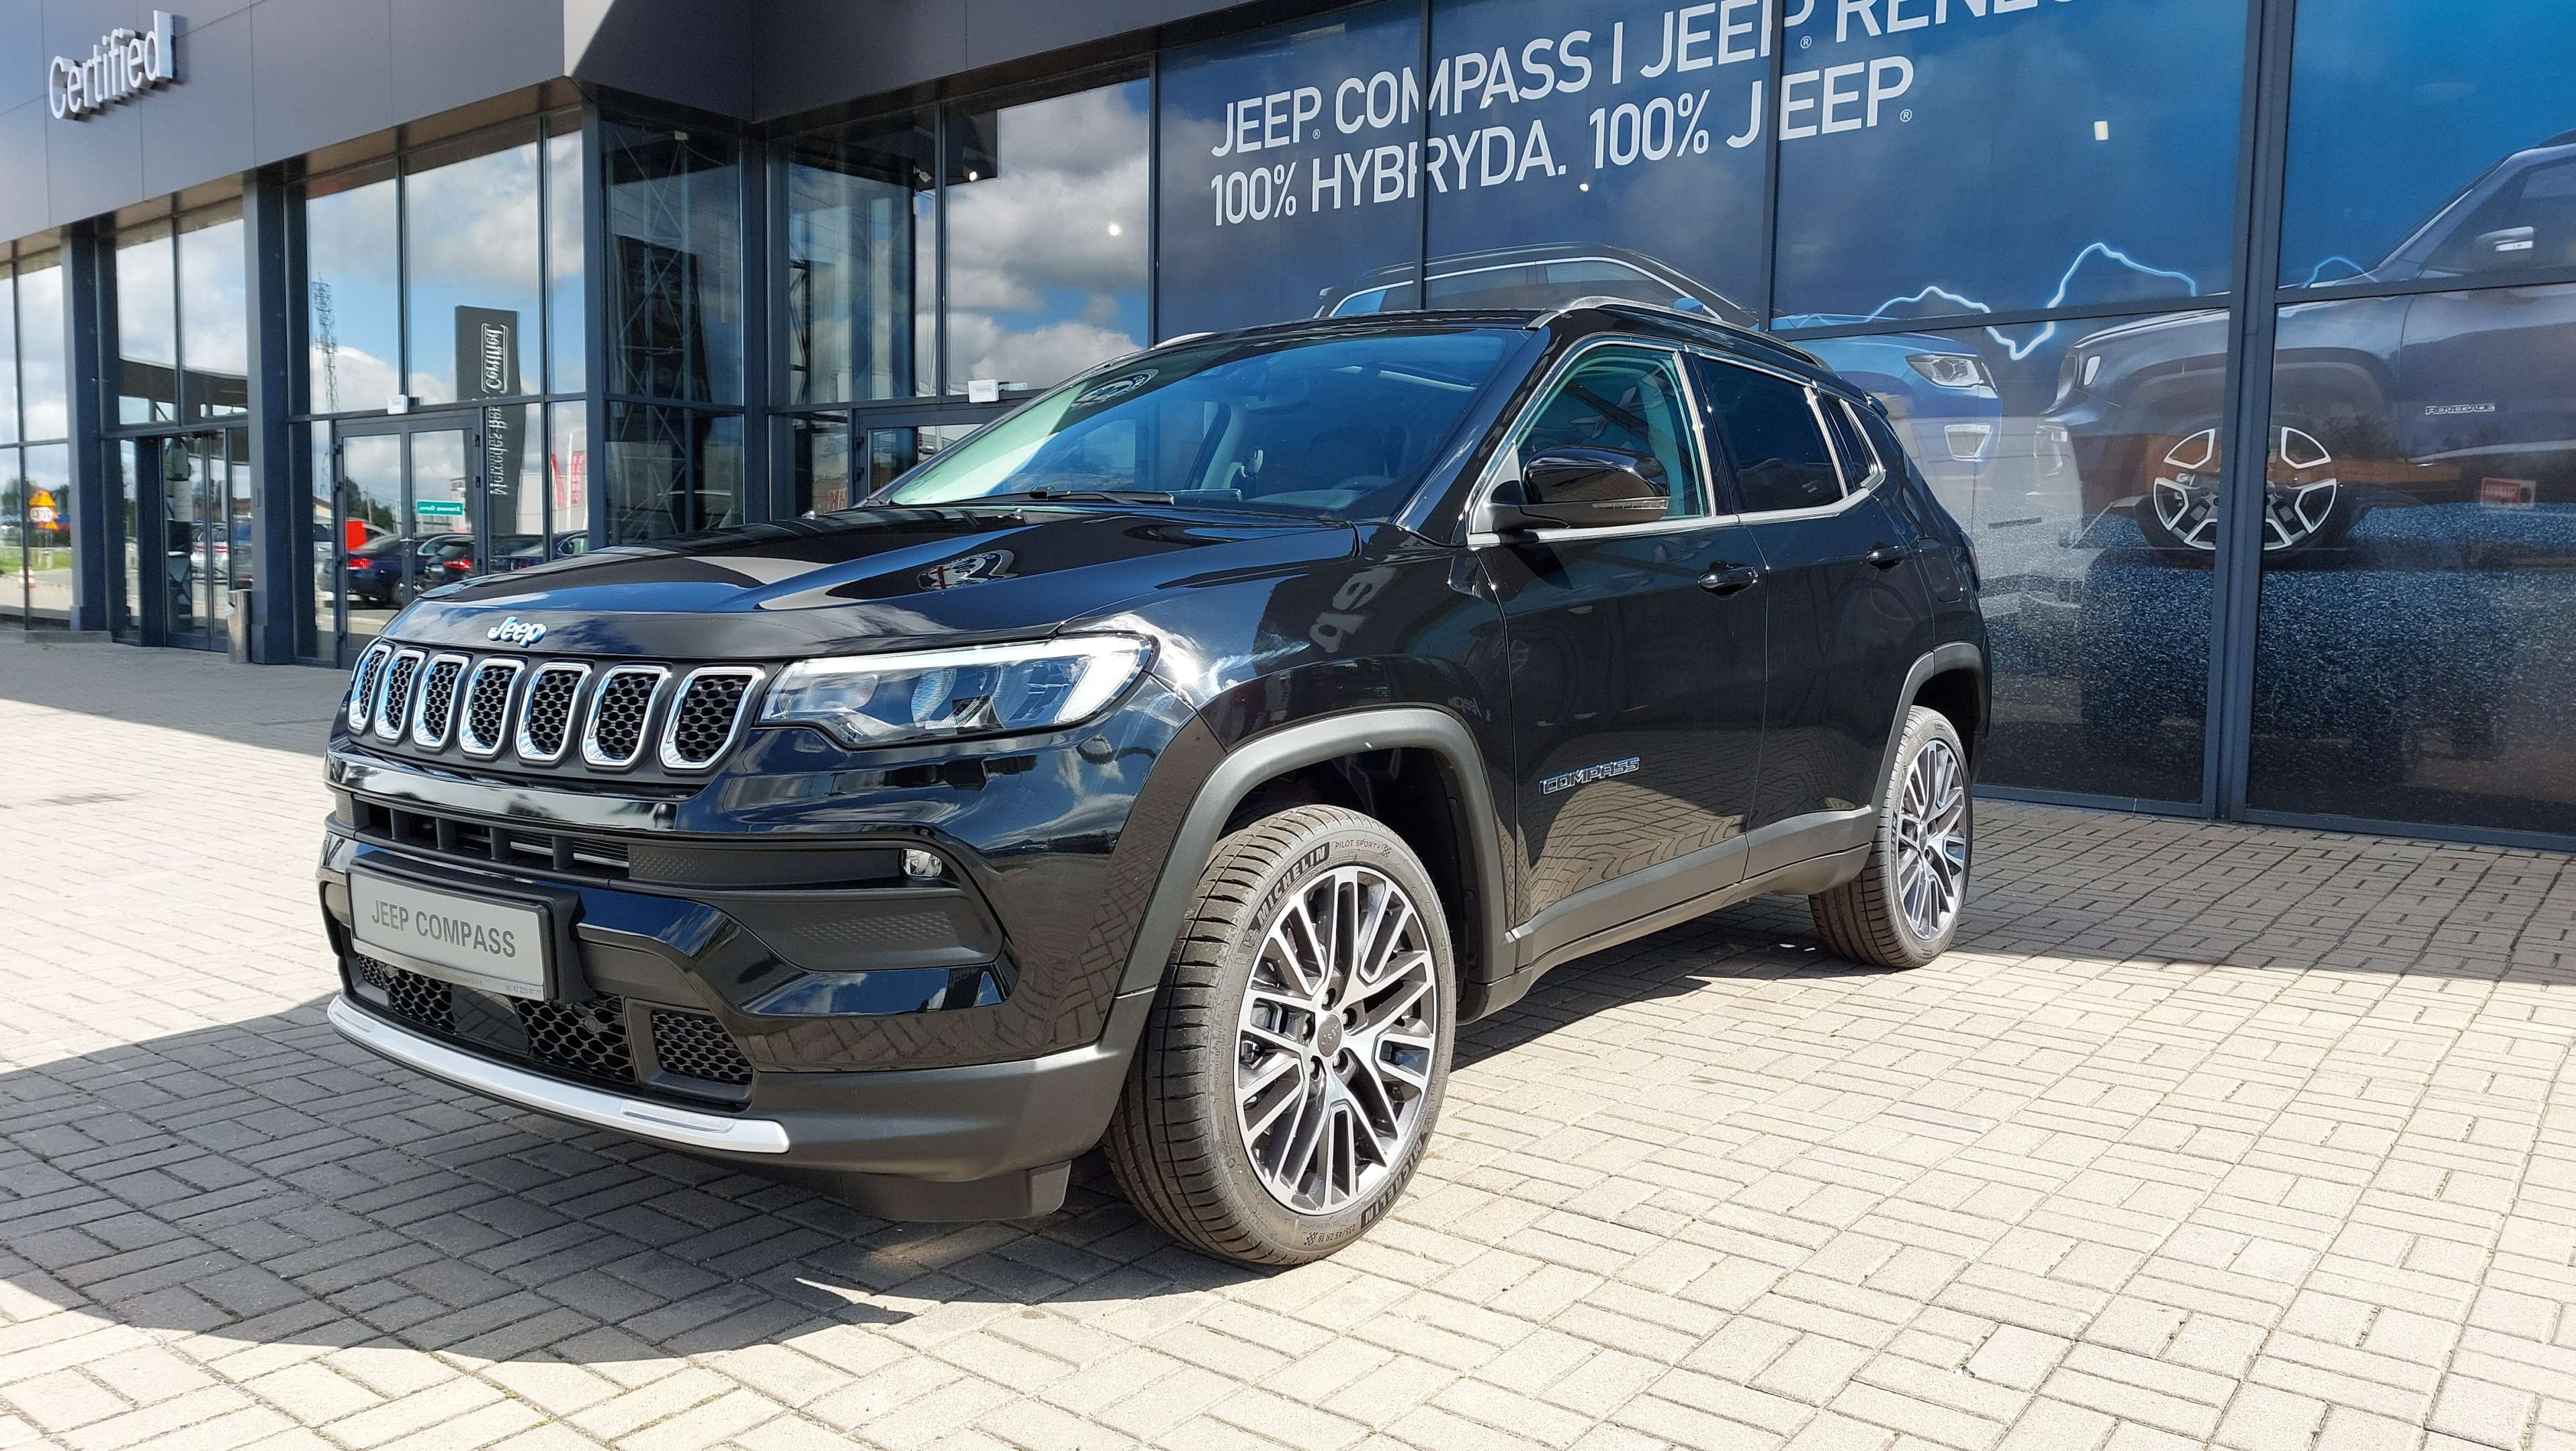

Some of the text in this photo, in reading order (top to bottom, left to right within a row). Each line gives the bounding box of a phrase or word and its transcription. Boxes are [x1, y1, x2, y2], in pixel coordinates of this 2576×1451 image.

[49, 9, 172, 120] Certified
[1335, 30, 1593, 134] COMPASS
[1211, 161, 1298, 226] 100%
[1312, 119, 1567, 212] HYBRYDA.
[1589, 89, 1710, 169] 100%
[2426, 404, 2495, 415] RENEGADE
[487, 616, 547, 648] Jeep
[1539, 756, 1640, 795] COMPASS
[1335, 839, 1354, 849] PILOT
[1356, 839, 1377, 849] SPORT
[1257, 846, 1326, 928] MICHELIN
[371, 900, 515, 957] JEEP COMPASS
[1364, 1138, 1423, 1225] MICHELIN
